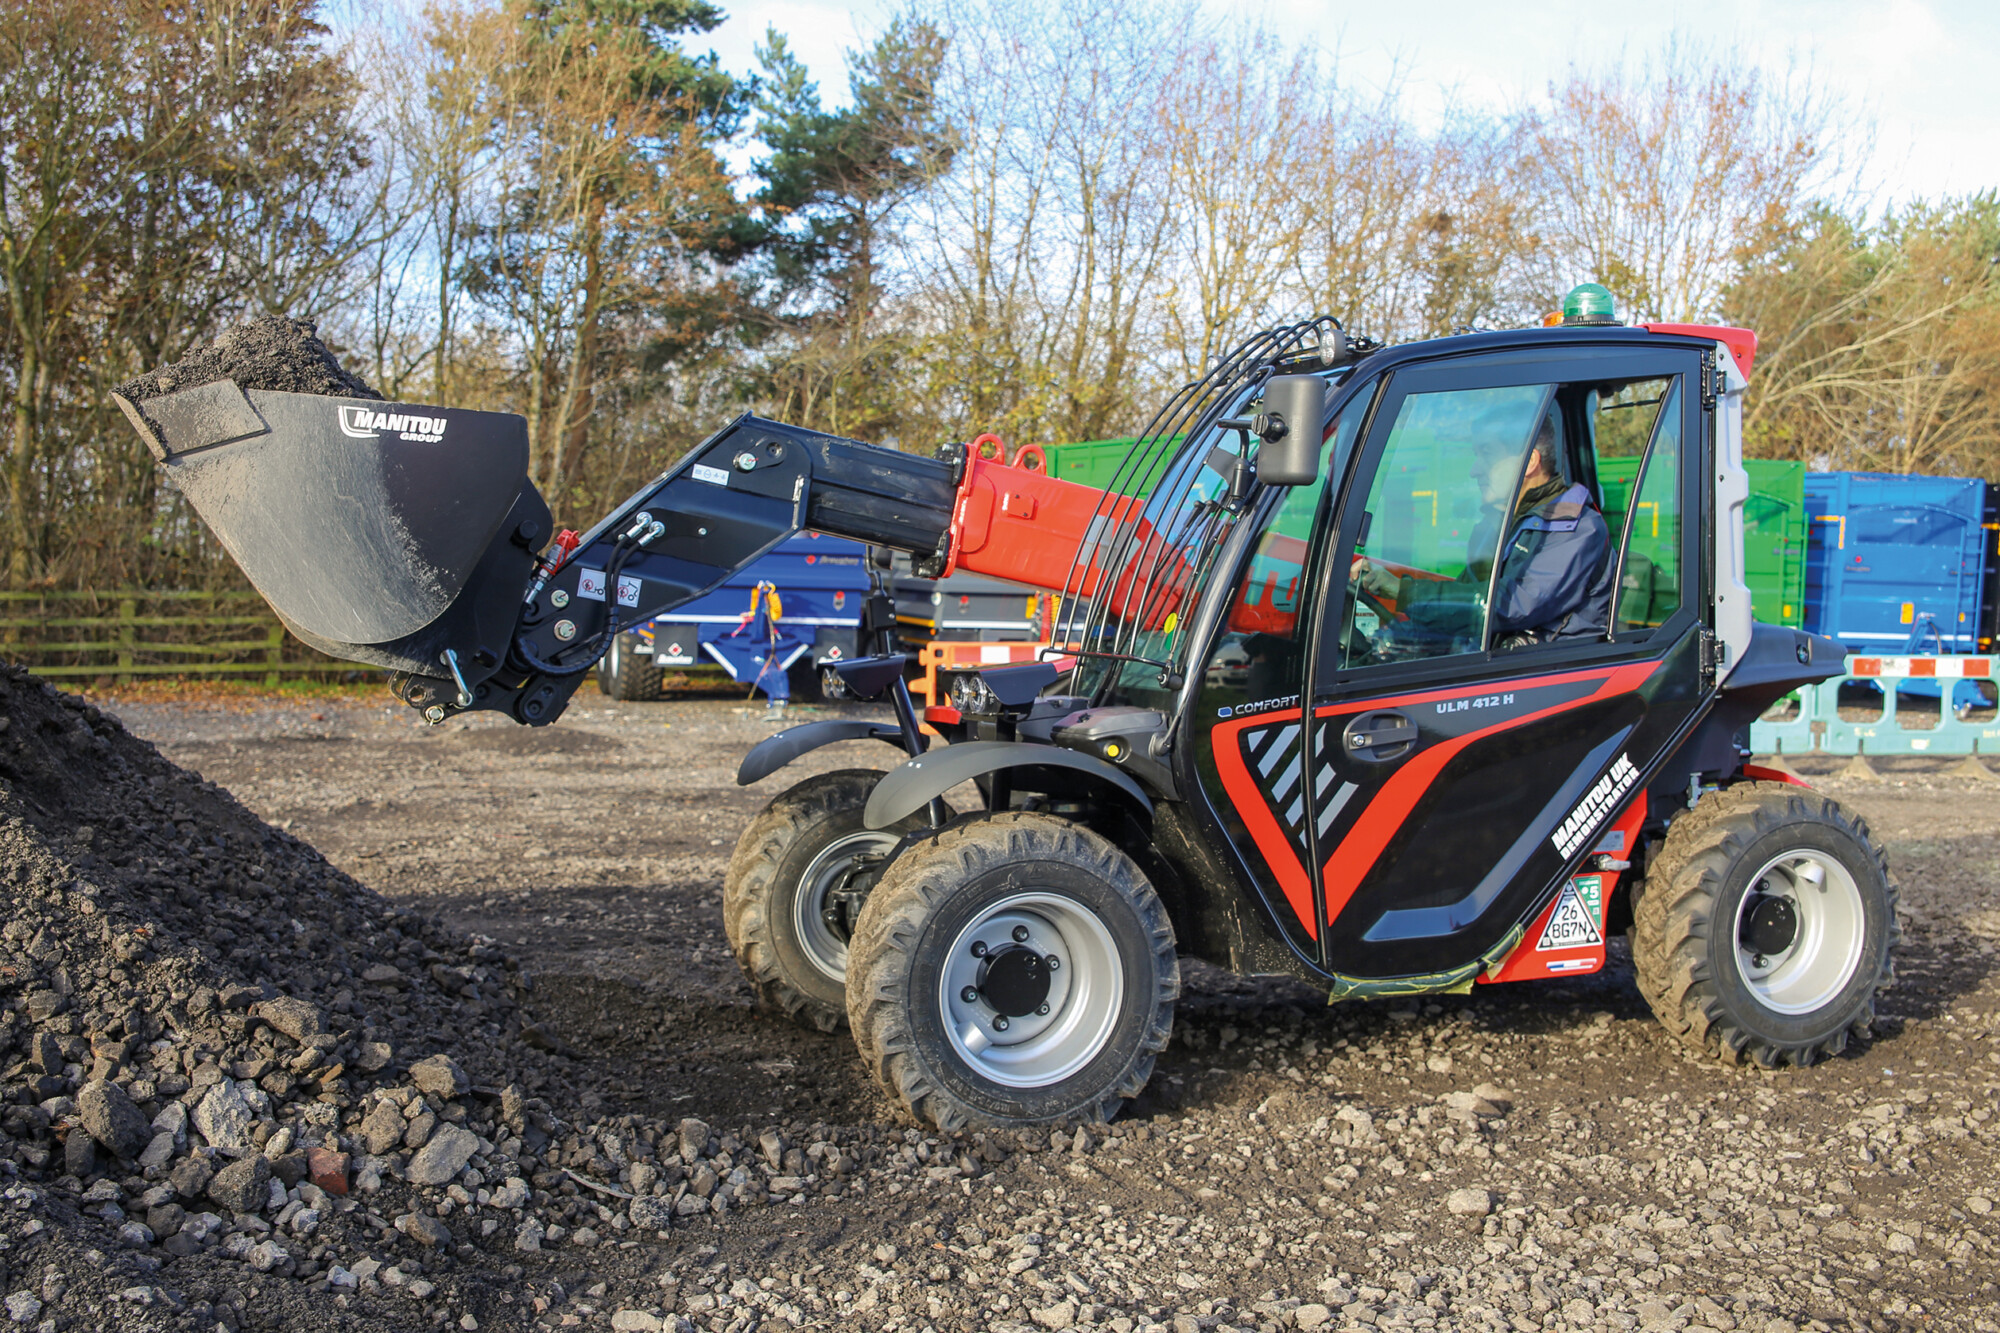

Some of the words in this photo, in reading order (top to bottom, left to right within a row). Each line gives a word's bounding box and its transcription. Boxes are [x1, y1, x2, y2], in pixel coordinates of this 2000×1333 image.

[354, 410, 447, 435] MANITOU
[400, 431, 443, 443] GROUP
[1235, 694, 1300, 715] COMFORT
[1436, 700, 1469, 714] ULM
[1472, 696, 1500, 708] 412
[1503, 693, 1514, 705] H
[1551, 773, 1613, 851] MANITOU
[1609, 751, 1634, 782] UK
[1559, 766, 1640, 861] DEMONSTRATOR
[1561, 905, 1578, 921] 26
[1552, 920, 1588, 938] BG7N
